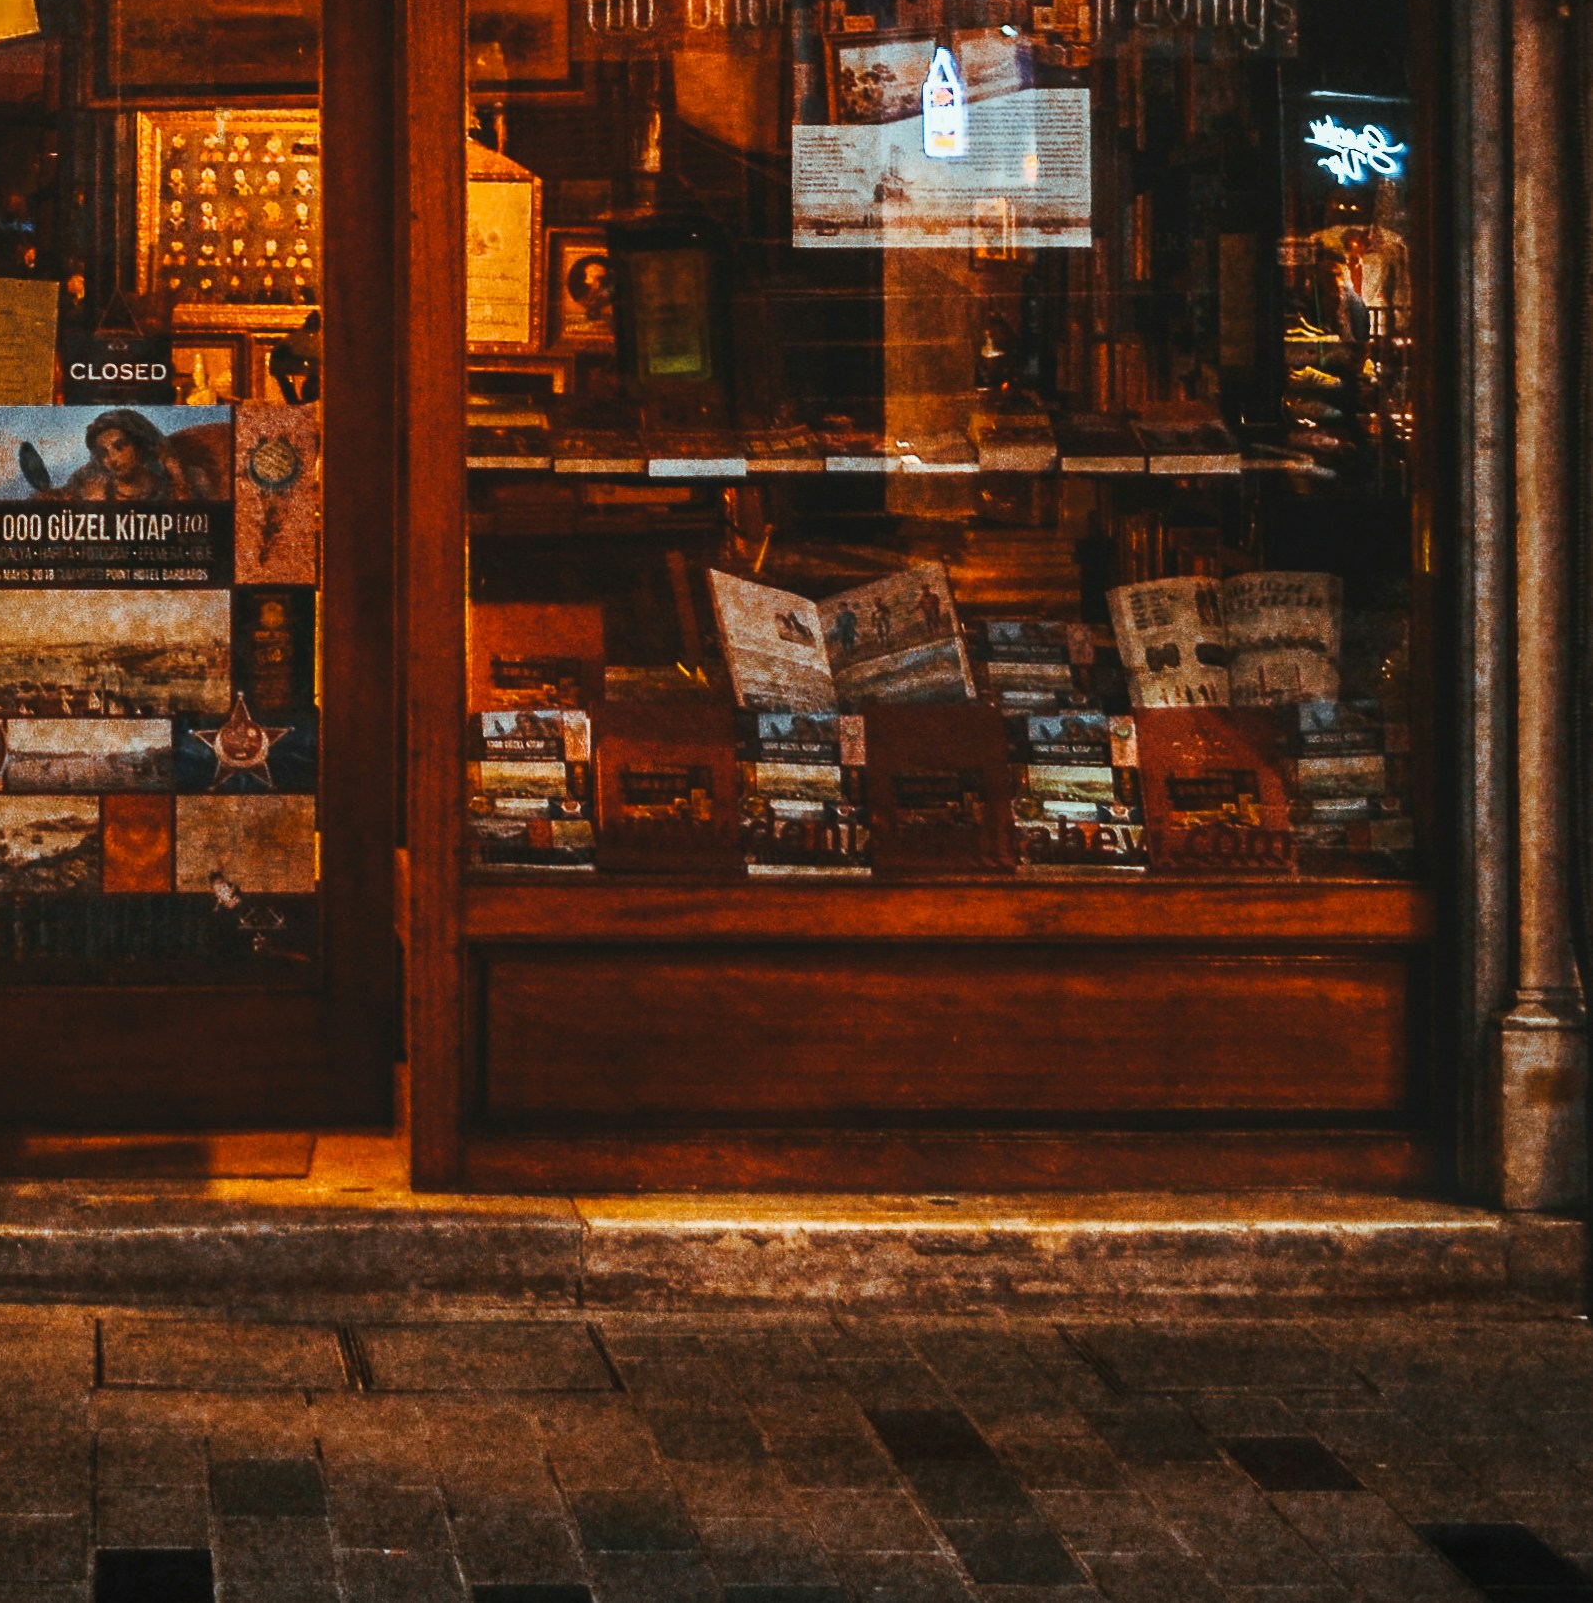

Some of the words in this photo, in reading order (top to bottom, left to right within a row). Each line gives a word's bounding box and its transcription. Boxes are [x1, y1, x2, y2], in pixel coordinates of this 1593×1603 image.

[70, 362, 167, 380] CLOSED
[47, 509, 111, 541] GÜZEL
[115, 509, 173, 541] KİTAP
[3, 568, 30, 581] MAYIS
[105, 568, 131, 581] POINT
[133, 568, 160, 581] HOTEL
